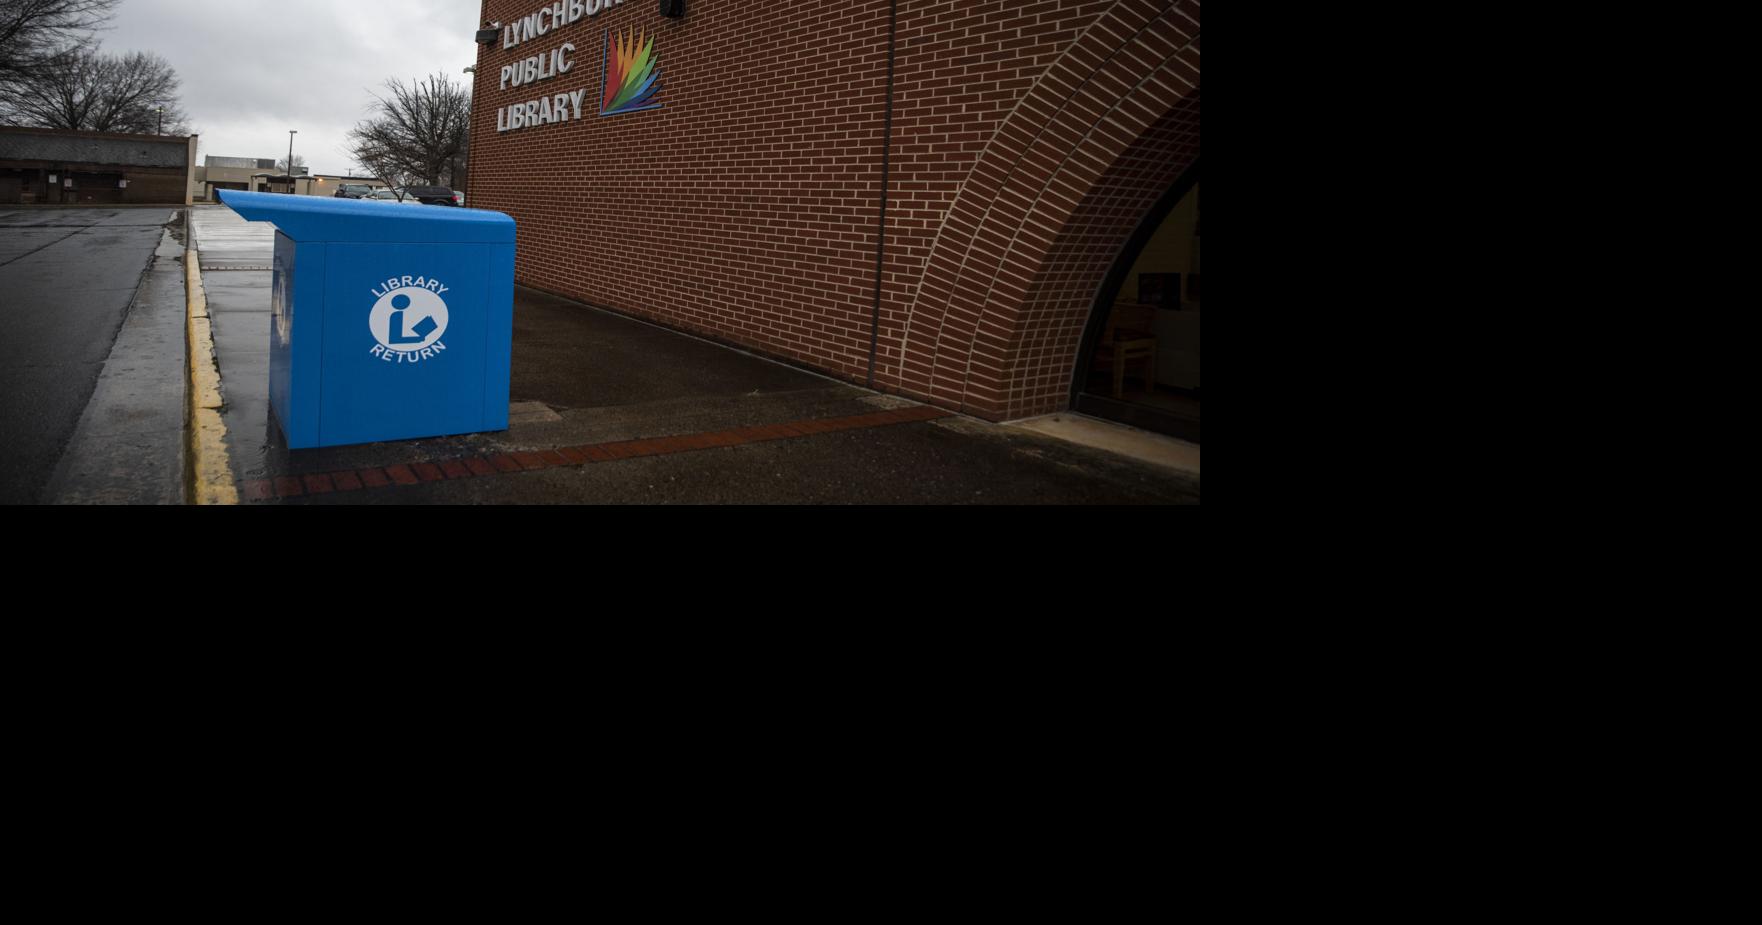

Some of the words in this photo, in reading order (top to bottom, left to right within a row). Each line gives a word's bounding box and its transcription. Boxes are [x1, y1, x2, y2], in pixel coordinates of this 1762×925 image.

[503, 0, 623, 50] LYNCHBU
[500, 42, 576, 91] PUBLIC
[497, 88, 587, 132] LIBRARY
[371, 275, 449, 298] LIBRARY
[369, 340, 447, 364] RETURN
